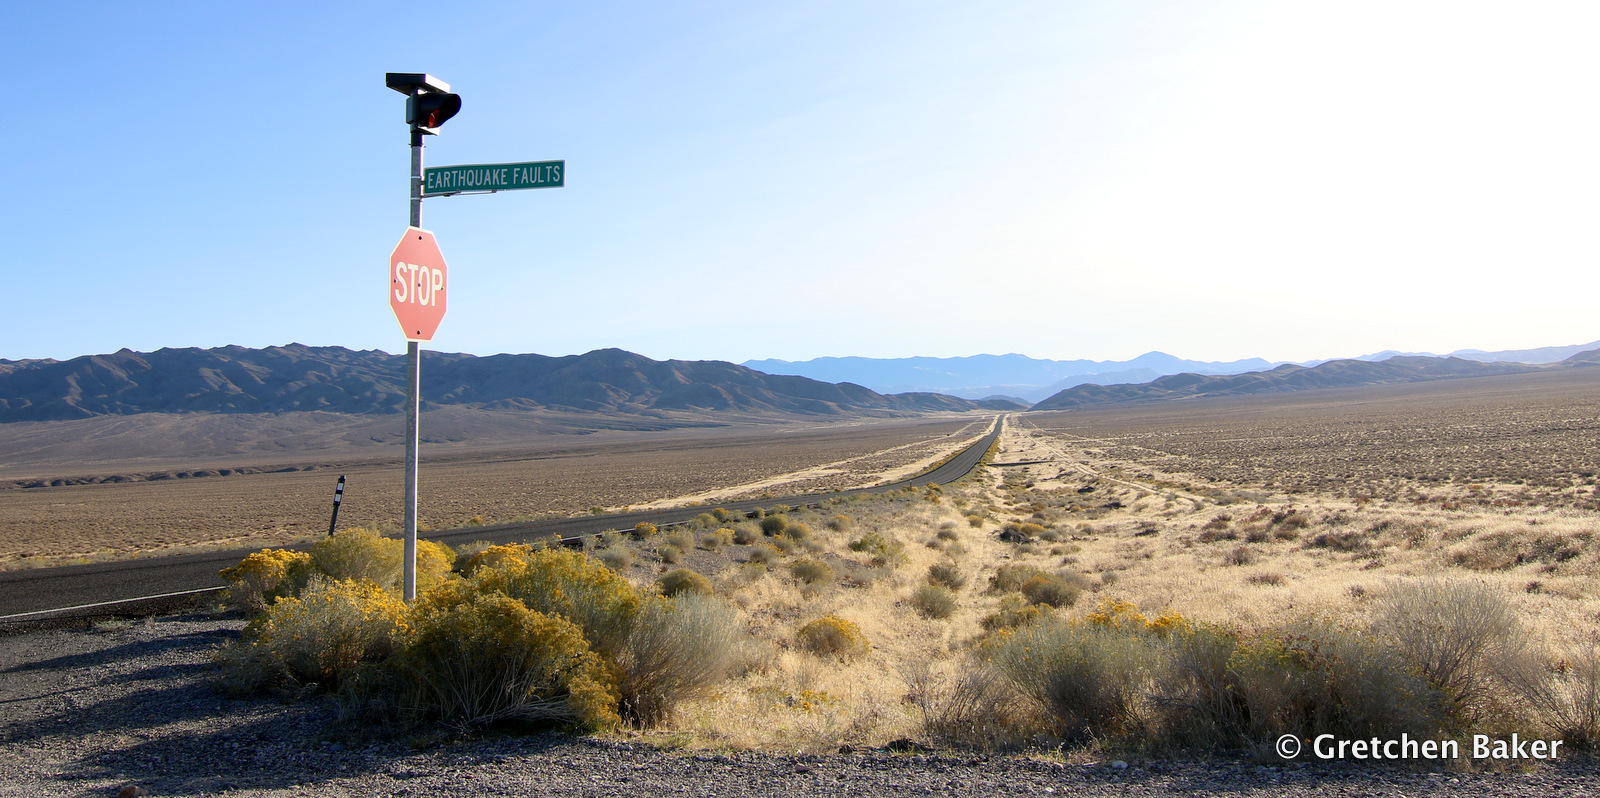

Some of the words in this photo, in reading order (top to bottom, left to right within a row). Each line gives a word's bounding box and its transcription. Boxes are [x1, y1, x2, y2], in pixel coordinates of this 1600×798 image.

[427, 168, 508, 189] EARTHQUAKE
[513, 165, 561, 185] FAULTS
[395, 261, 444, 306] STOP
